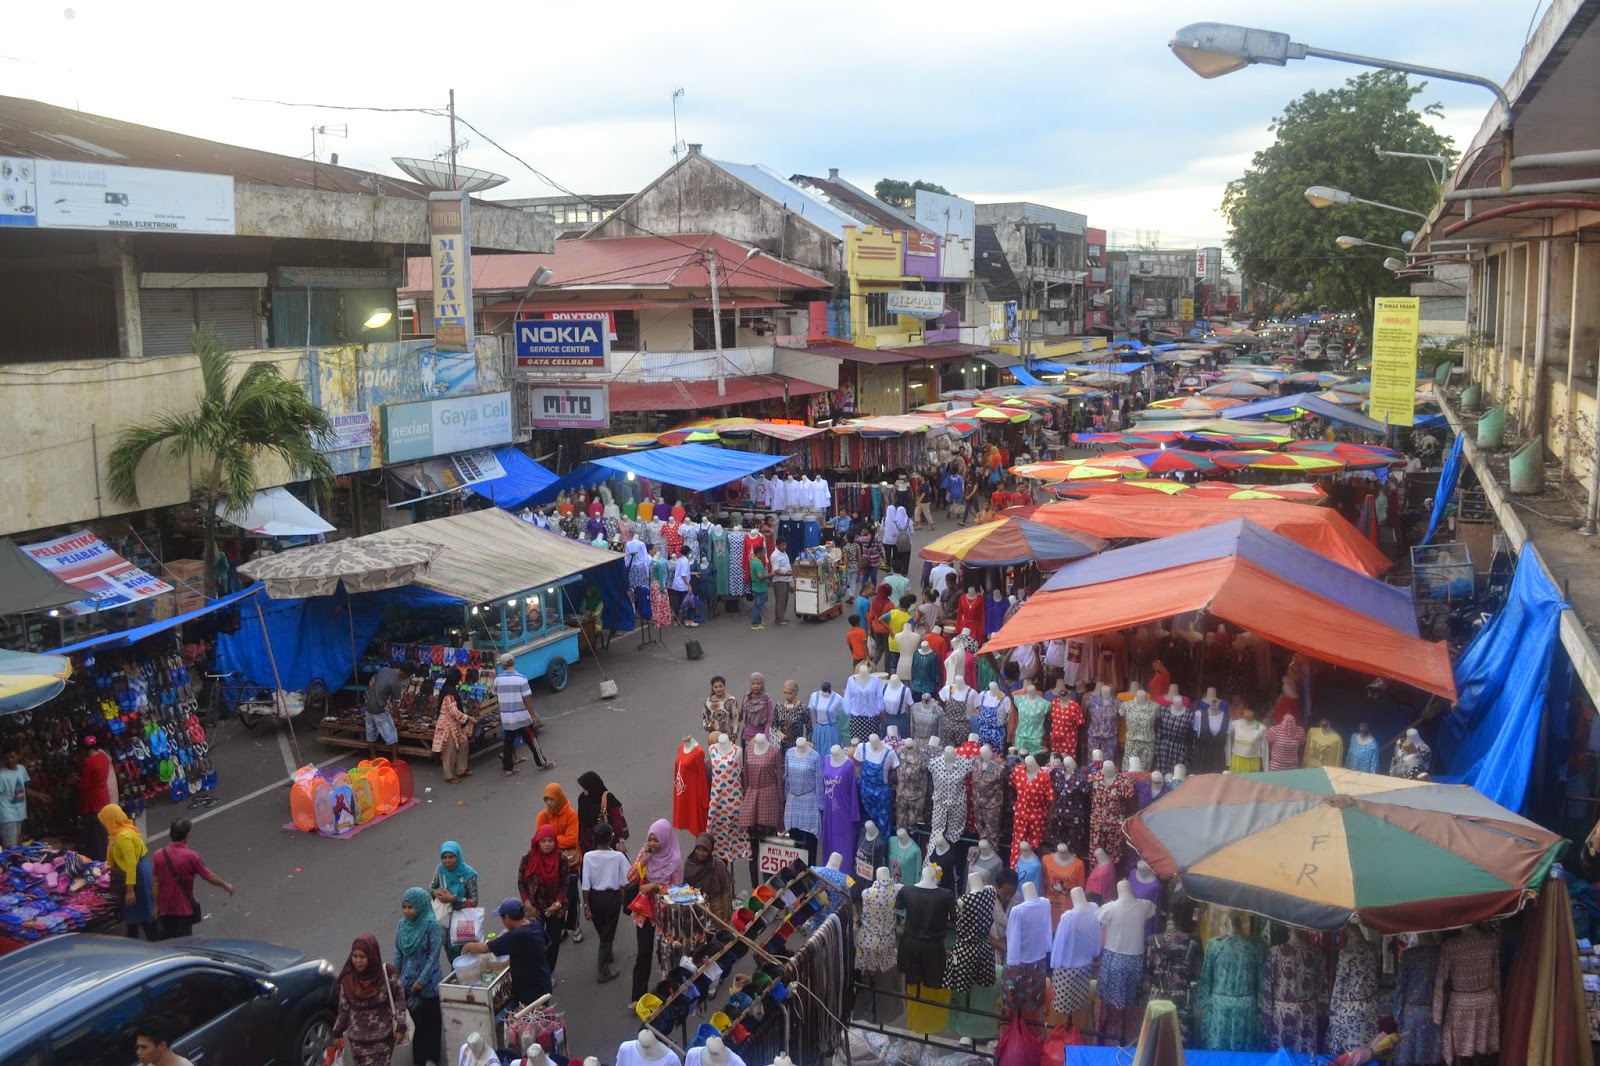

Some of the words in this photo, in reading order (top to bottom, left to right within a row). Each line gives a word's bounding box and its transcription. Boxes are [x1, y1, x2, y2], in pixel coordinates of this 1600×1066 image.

[109, 219, 134, 228] MASDA
[135, 221, 178, 230] ELEKTRONIK
[439, 238, 457, 301] MAZDA
[891, 294, 933, 308] CIPTA
[437, 304, 461, 316] TV
[521, 326, 599, 343] NOKIA
[529, 345, 560, 353] SERVICE
[561, 345, 590, 353] CENTER
[527, 358, 550, 366] GAYA
[551, 358, 594, 366] CELLULAR
[440, 404, 478, 427] Gaya
[482, 401, 509, 419] Cell
[391, 419, 430, 439] nexian
[30, 532, 101, 558] PELANTIKA
[56, 546, 102, 566] PEJABAT
[1311, 834, 1331, 852] F
[767, 846, 782, 857] RATA
[784, 848, 800, 859] RATA
[1296, 863, 1318, 888] R
